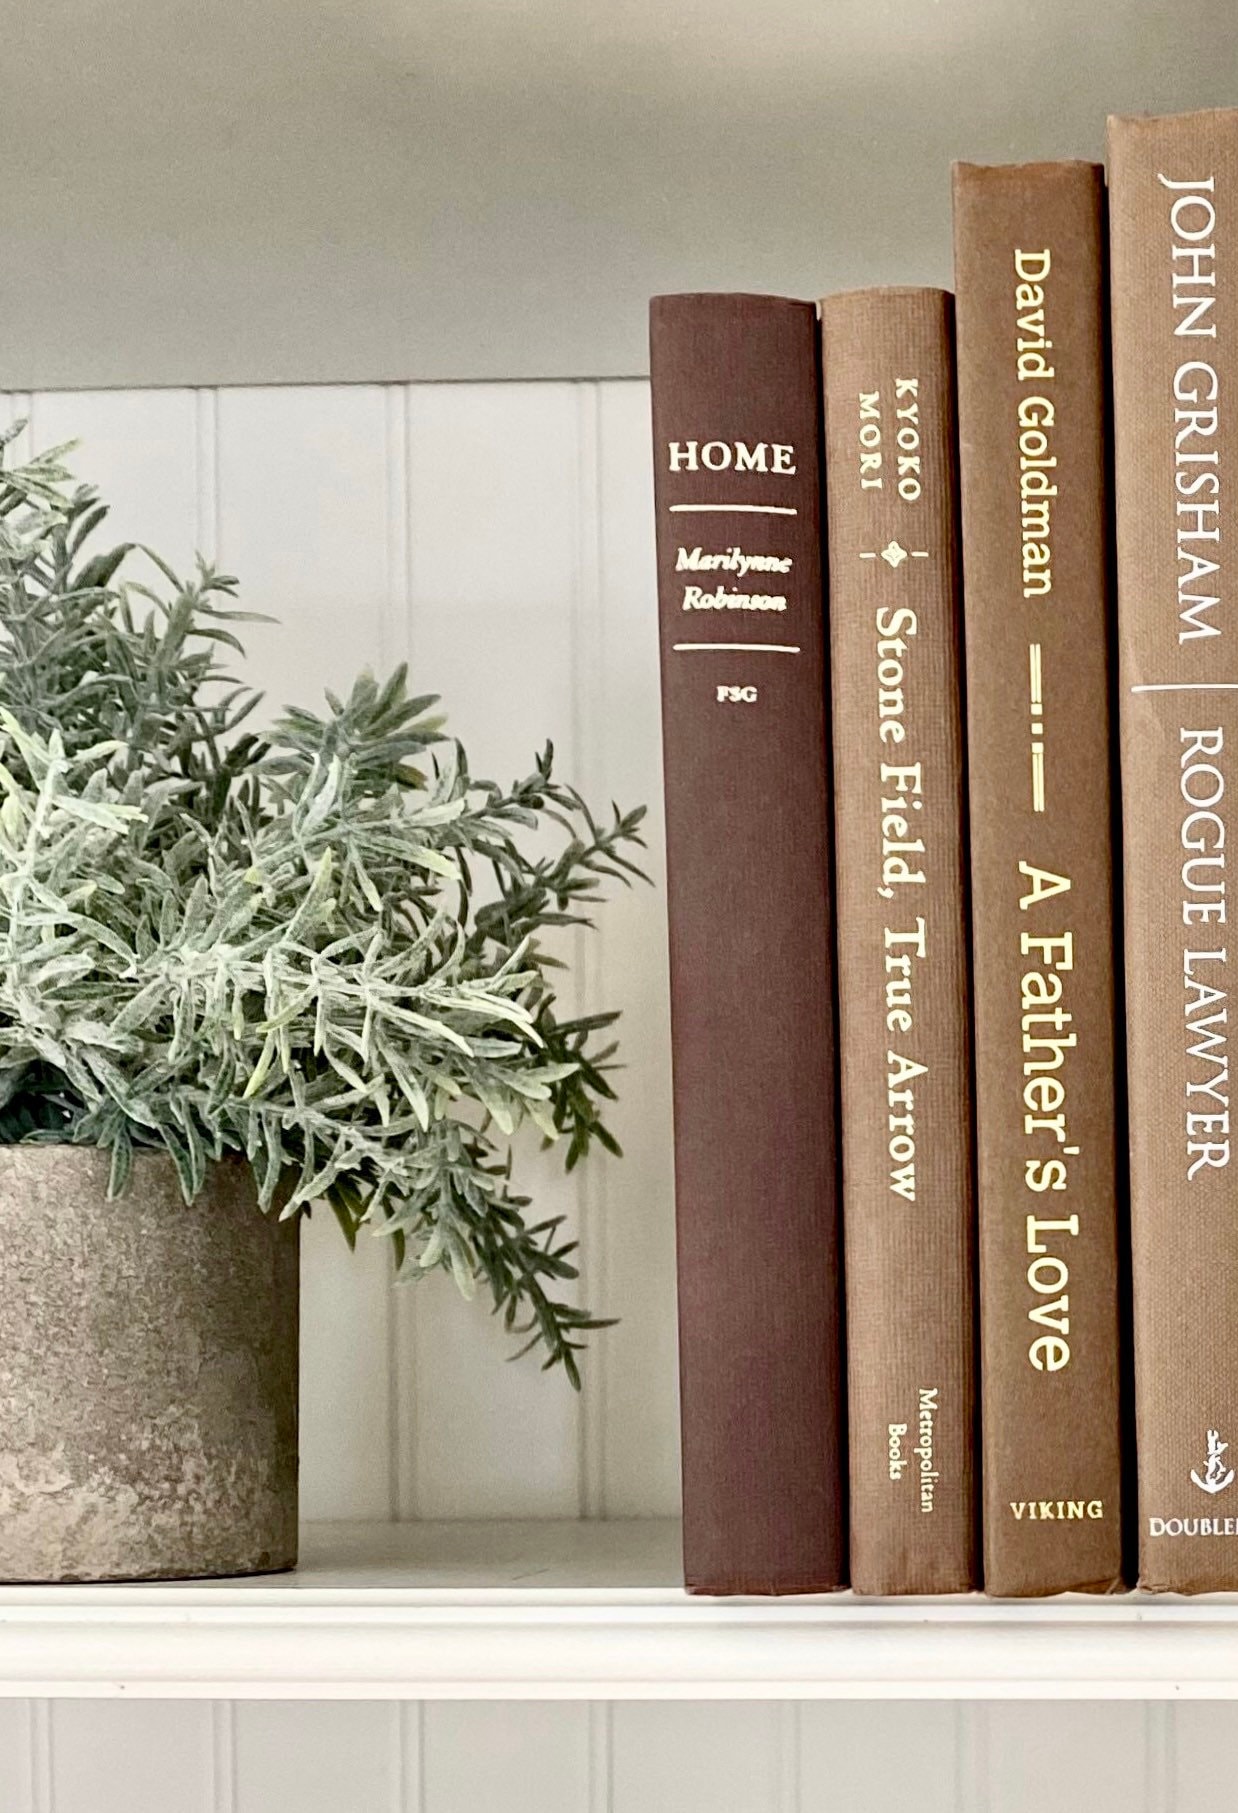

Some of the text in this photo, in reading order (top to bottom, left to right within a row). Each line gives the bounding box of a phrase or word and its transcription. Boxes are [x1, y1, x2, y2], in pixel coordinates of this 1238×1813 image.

[668, 441, 796, 475] HOME
[858, 390, 883, 489] MORI
[895, 377, 921, 501] KYOKO
[1014, 248, 1058, 599] David Goldman
[1157, 173, 1222, 645] JOHN GRISHAM
[682, 585, 787, 612] Robinson
[716, 685, 758, 703] FSG
[876, 606, 929, 1202] Stone Field, True Arrow
[1180, 726, 1230, 1181] ROGUE LAWYER
[1018, 860, 1080, 1372] A Father's Love
[888, 1423, 908, 1480] Books
[913, 1387, 940, 1513] Metropolitan
[1009, 1500, 1103, 1520] VIKING
